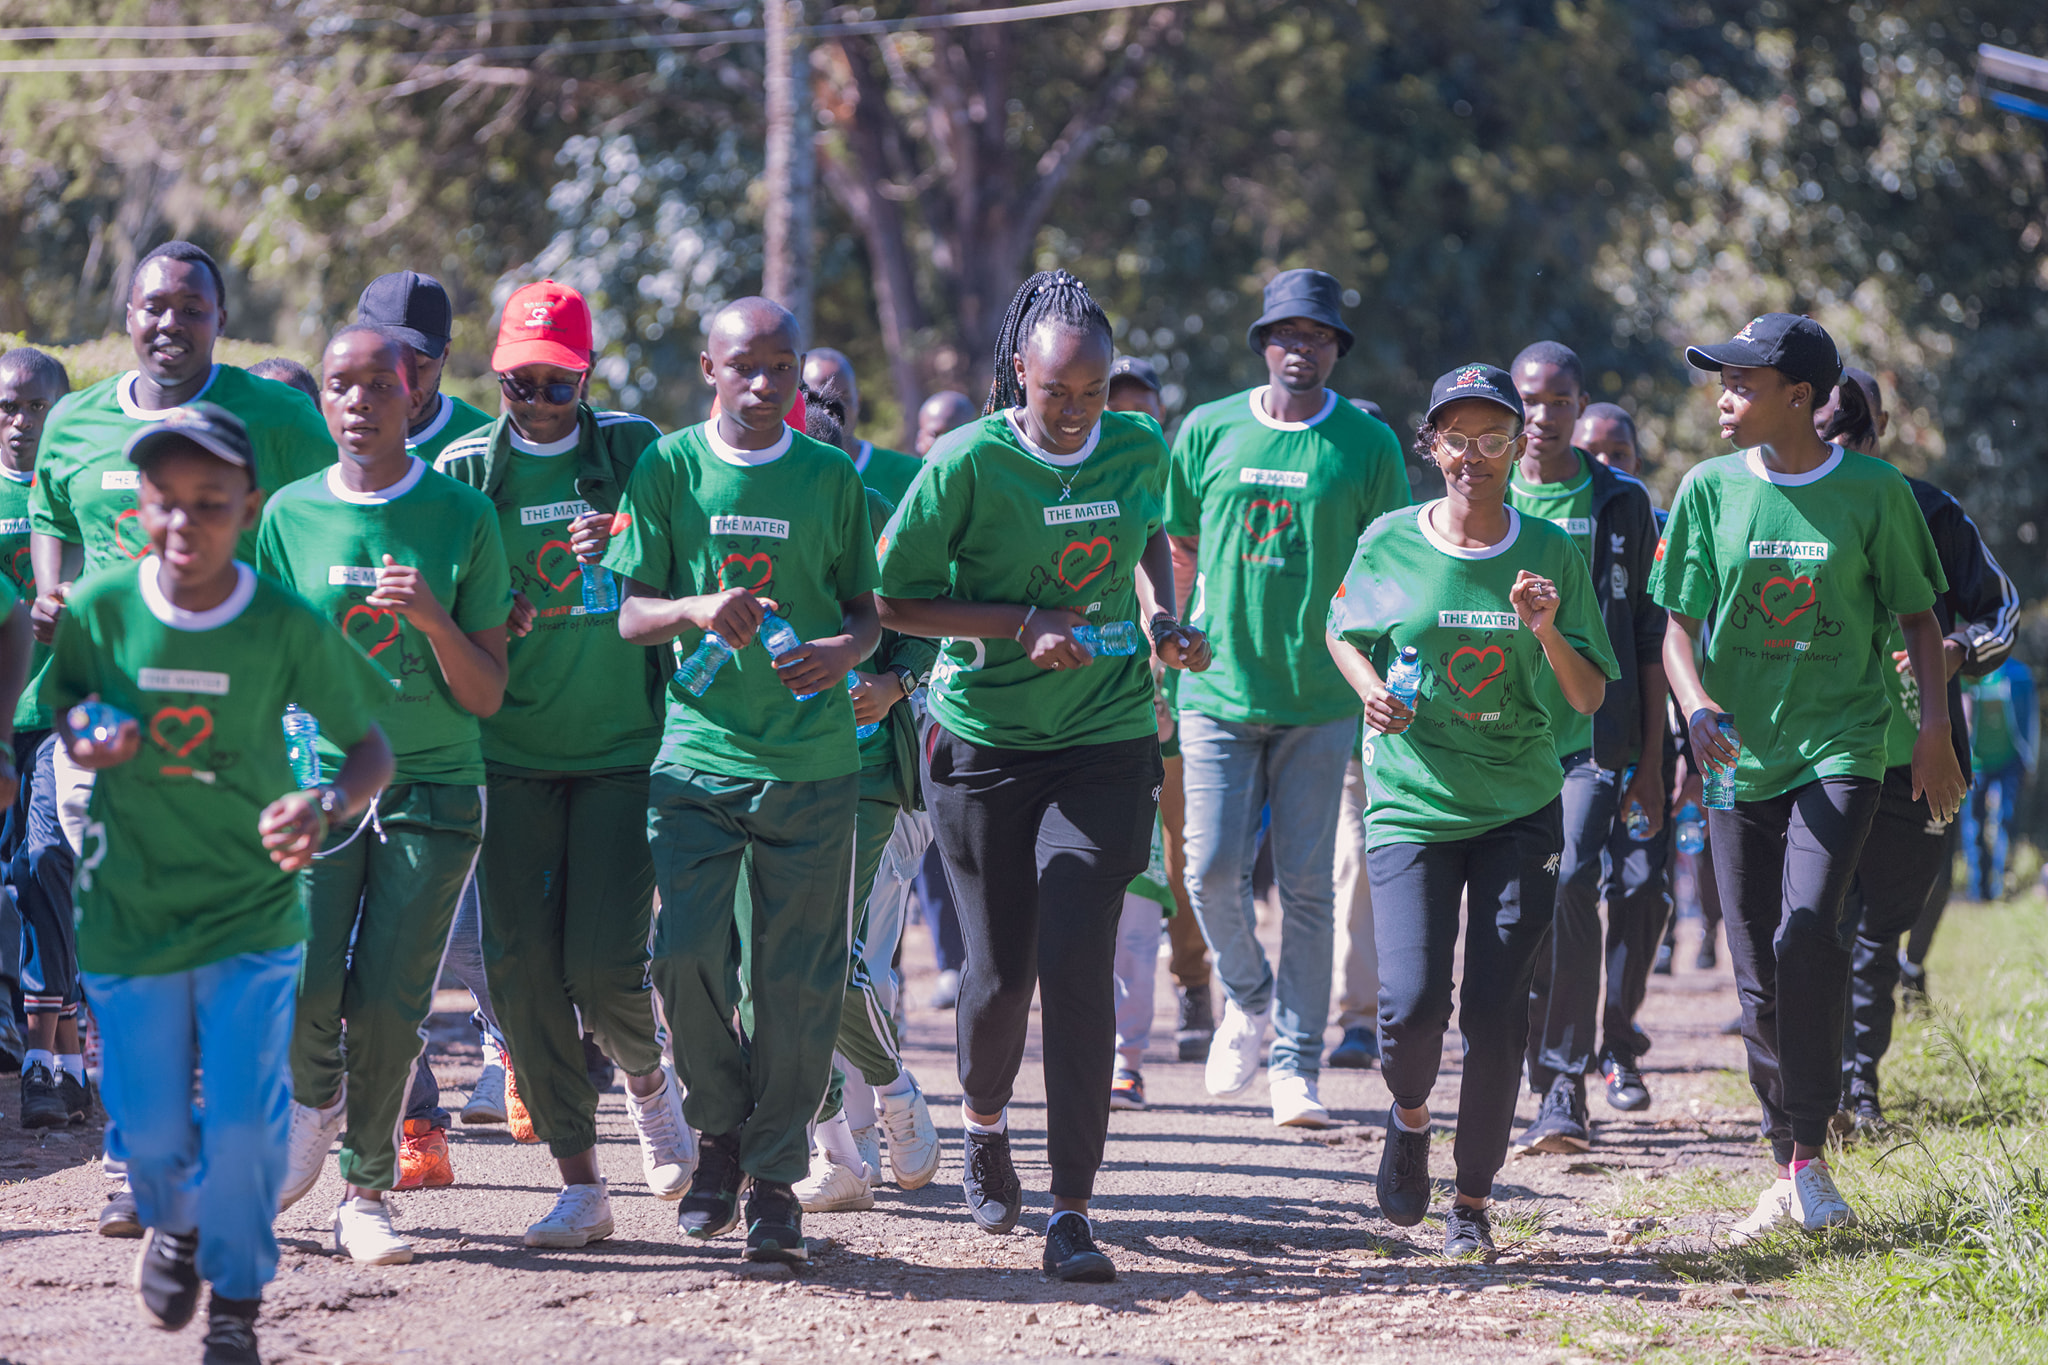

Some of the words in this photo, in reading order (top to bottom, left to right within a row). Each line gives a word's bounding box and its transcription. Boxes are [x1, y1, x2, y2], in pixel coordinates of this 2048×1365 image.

[525, 508, 550, 520] THE
[1048, 508, 1072, 521] THE
[1075, 503, 1117, 518] MATER
[715, 519, 739, 531] THE
[742, 520, 785, 535] MATER
[1753, 544, 1778, 555] THE
[1781, 544, 1824, 557] MATER
[1442, 613, 1468, 624] THE
[1471, 614, 1516, 627] MATER
[1761, 651, 1791, 663] Heart
[1480, 724, 1489, 734] of
